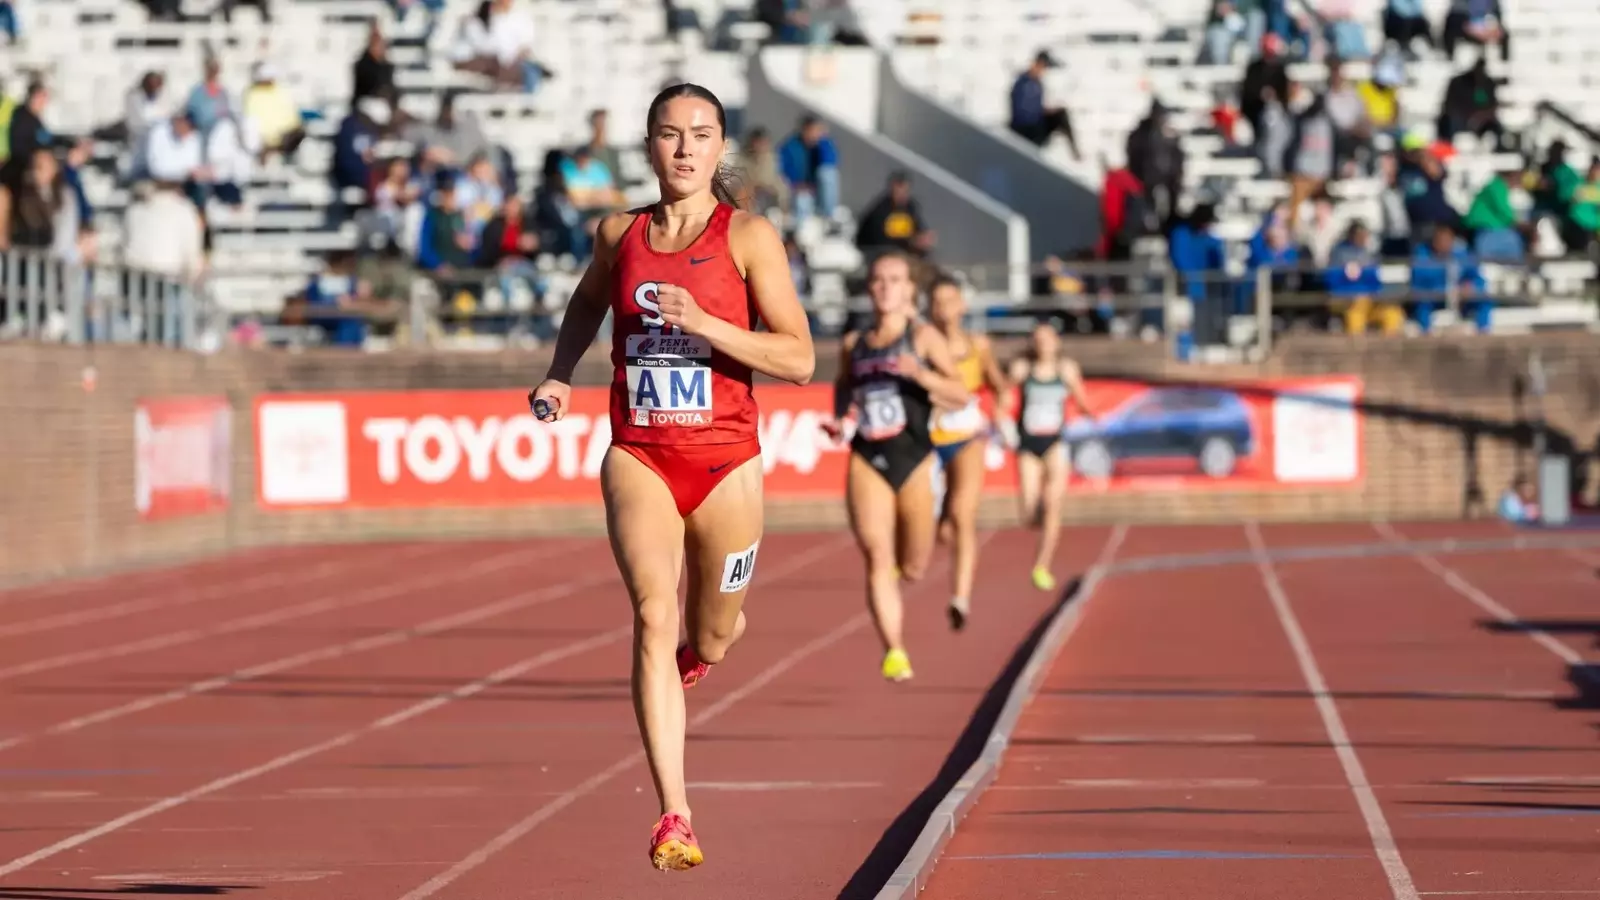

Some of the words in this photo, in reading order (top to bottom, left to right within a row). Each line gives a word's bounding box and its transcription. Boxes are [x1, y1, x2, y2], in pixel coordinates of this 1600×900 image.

[659, 338, 690, 346] PENN
[635, 369, 706, 408] AM
[651, 413, 704, 424] TOYOTA
